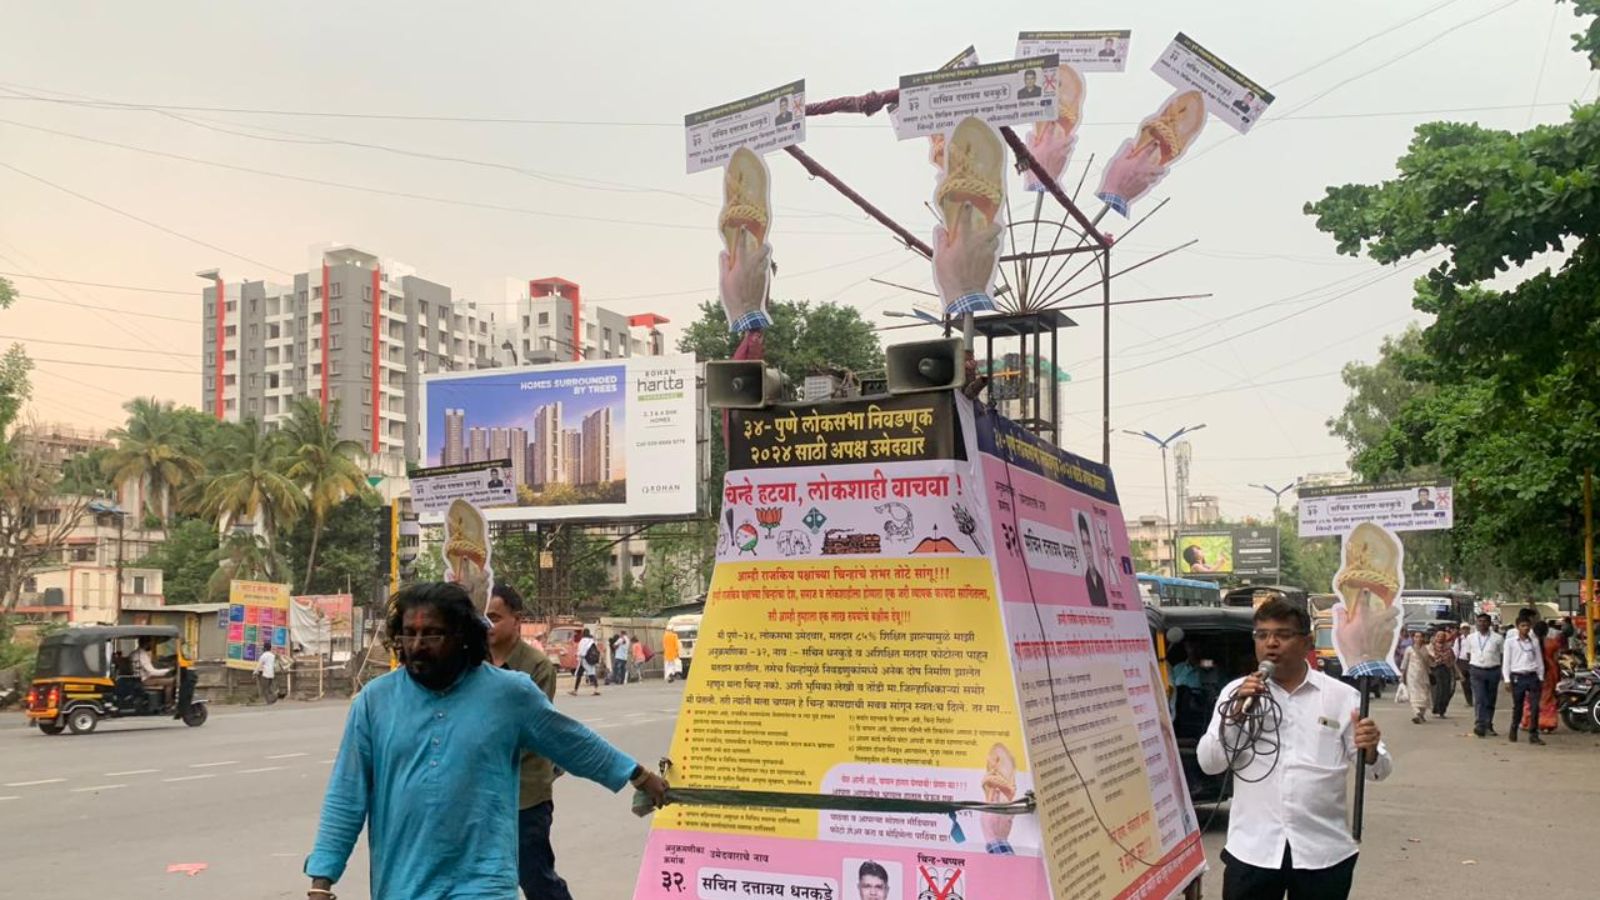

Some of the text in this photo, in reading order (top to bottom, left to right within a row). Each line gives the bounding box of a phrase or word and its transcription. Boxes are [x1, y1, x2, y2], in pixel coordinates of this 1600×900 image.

[645, 369, 676, 377] ROHAN
[520, 376, 618, 390] HOMES SURROUNDED
[574, 384, 618, 395] BY TREES
[637, 376, 684, 392] harita
[744, 405, 934, 442] ३४- पुणे लोकसभा निवडणूक
[751, 432, 926, 464] २०२४ साठी अपक्ष उमेदवार
[758, 482, 802, 506] हटवा,
[807, 469, 888, 500] लोकशाही
[891, 476, 950, 498] वाचवा
[702, 874, 737, 894] सचिन
[741, 880, 784, 897] दत्तात्रय
